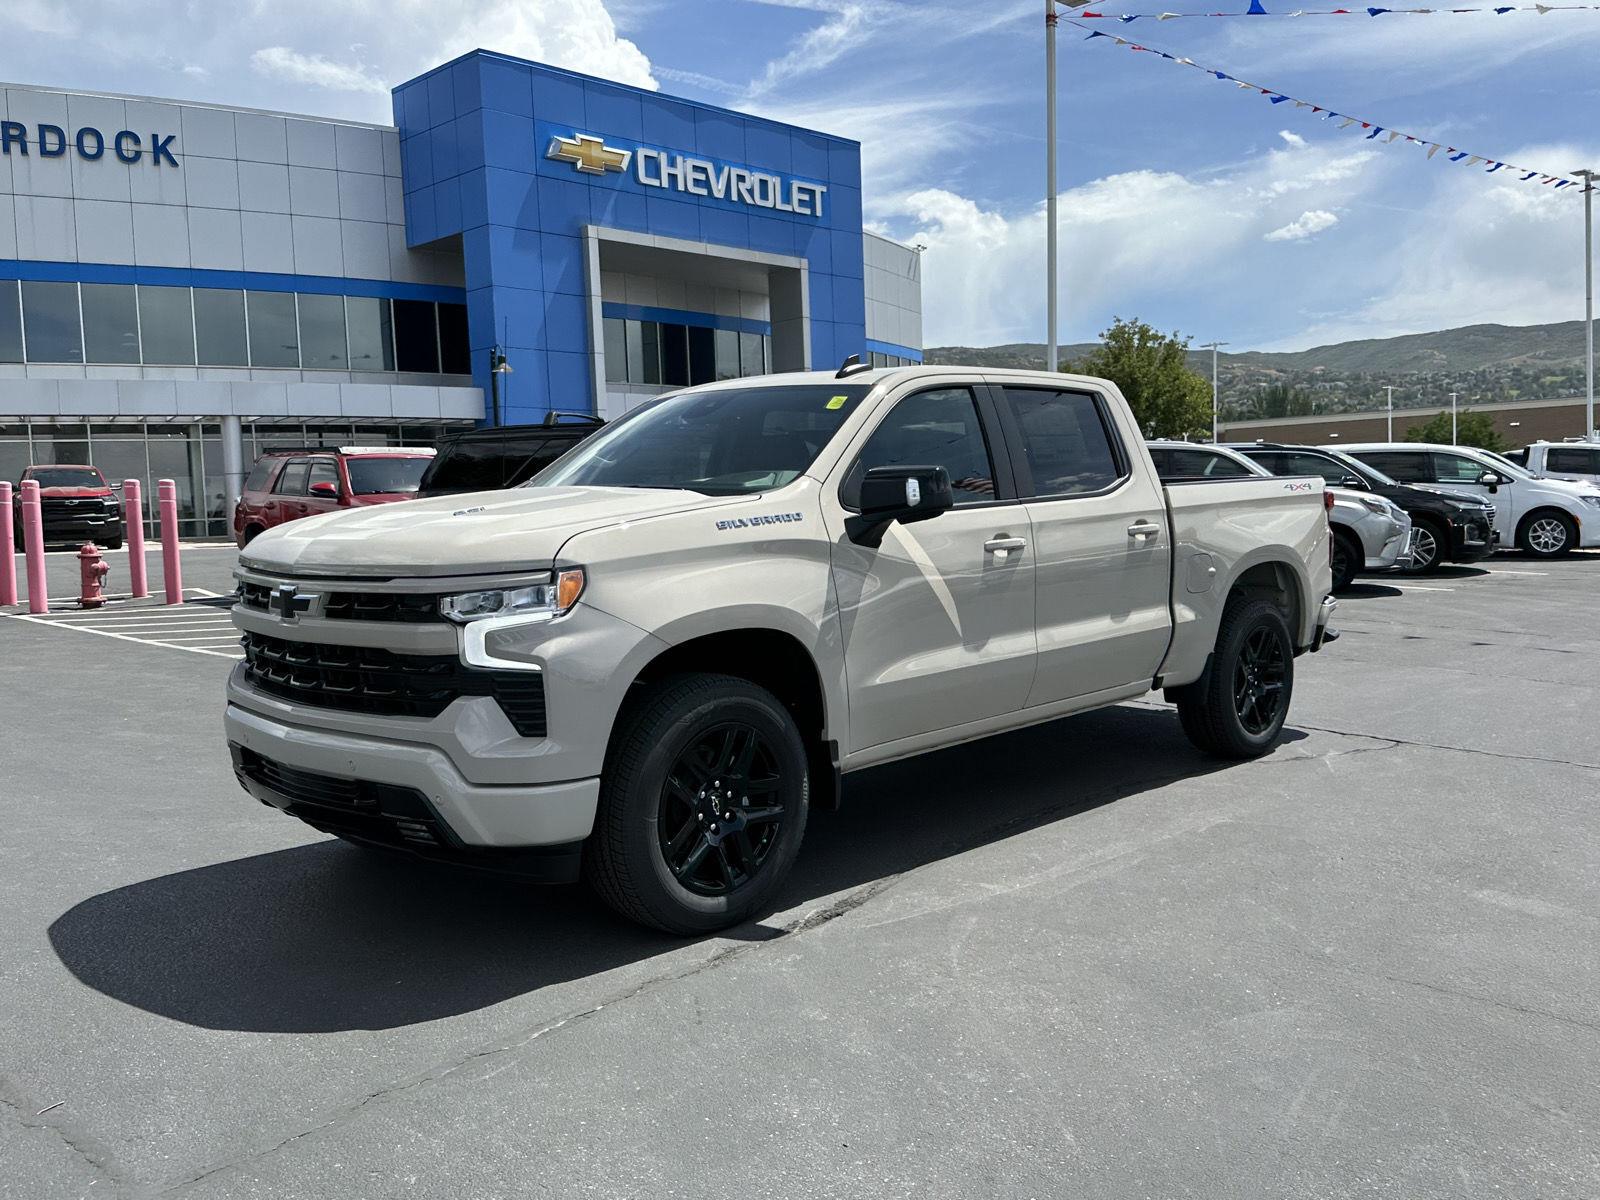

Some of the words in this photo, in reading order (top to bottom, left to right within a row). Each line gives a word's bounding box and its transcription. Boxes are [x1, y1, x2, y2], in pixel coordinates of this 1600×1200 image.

[1, 121, 179, 167] RDOCK
[636, 148, 827, 217] CHEVROLET
[716, 512, 804, 530] SILVERADO
